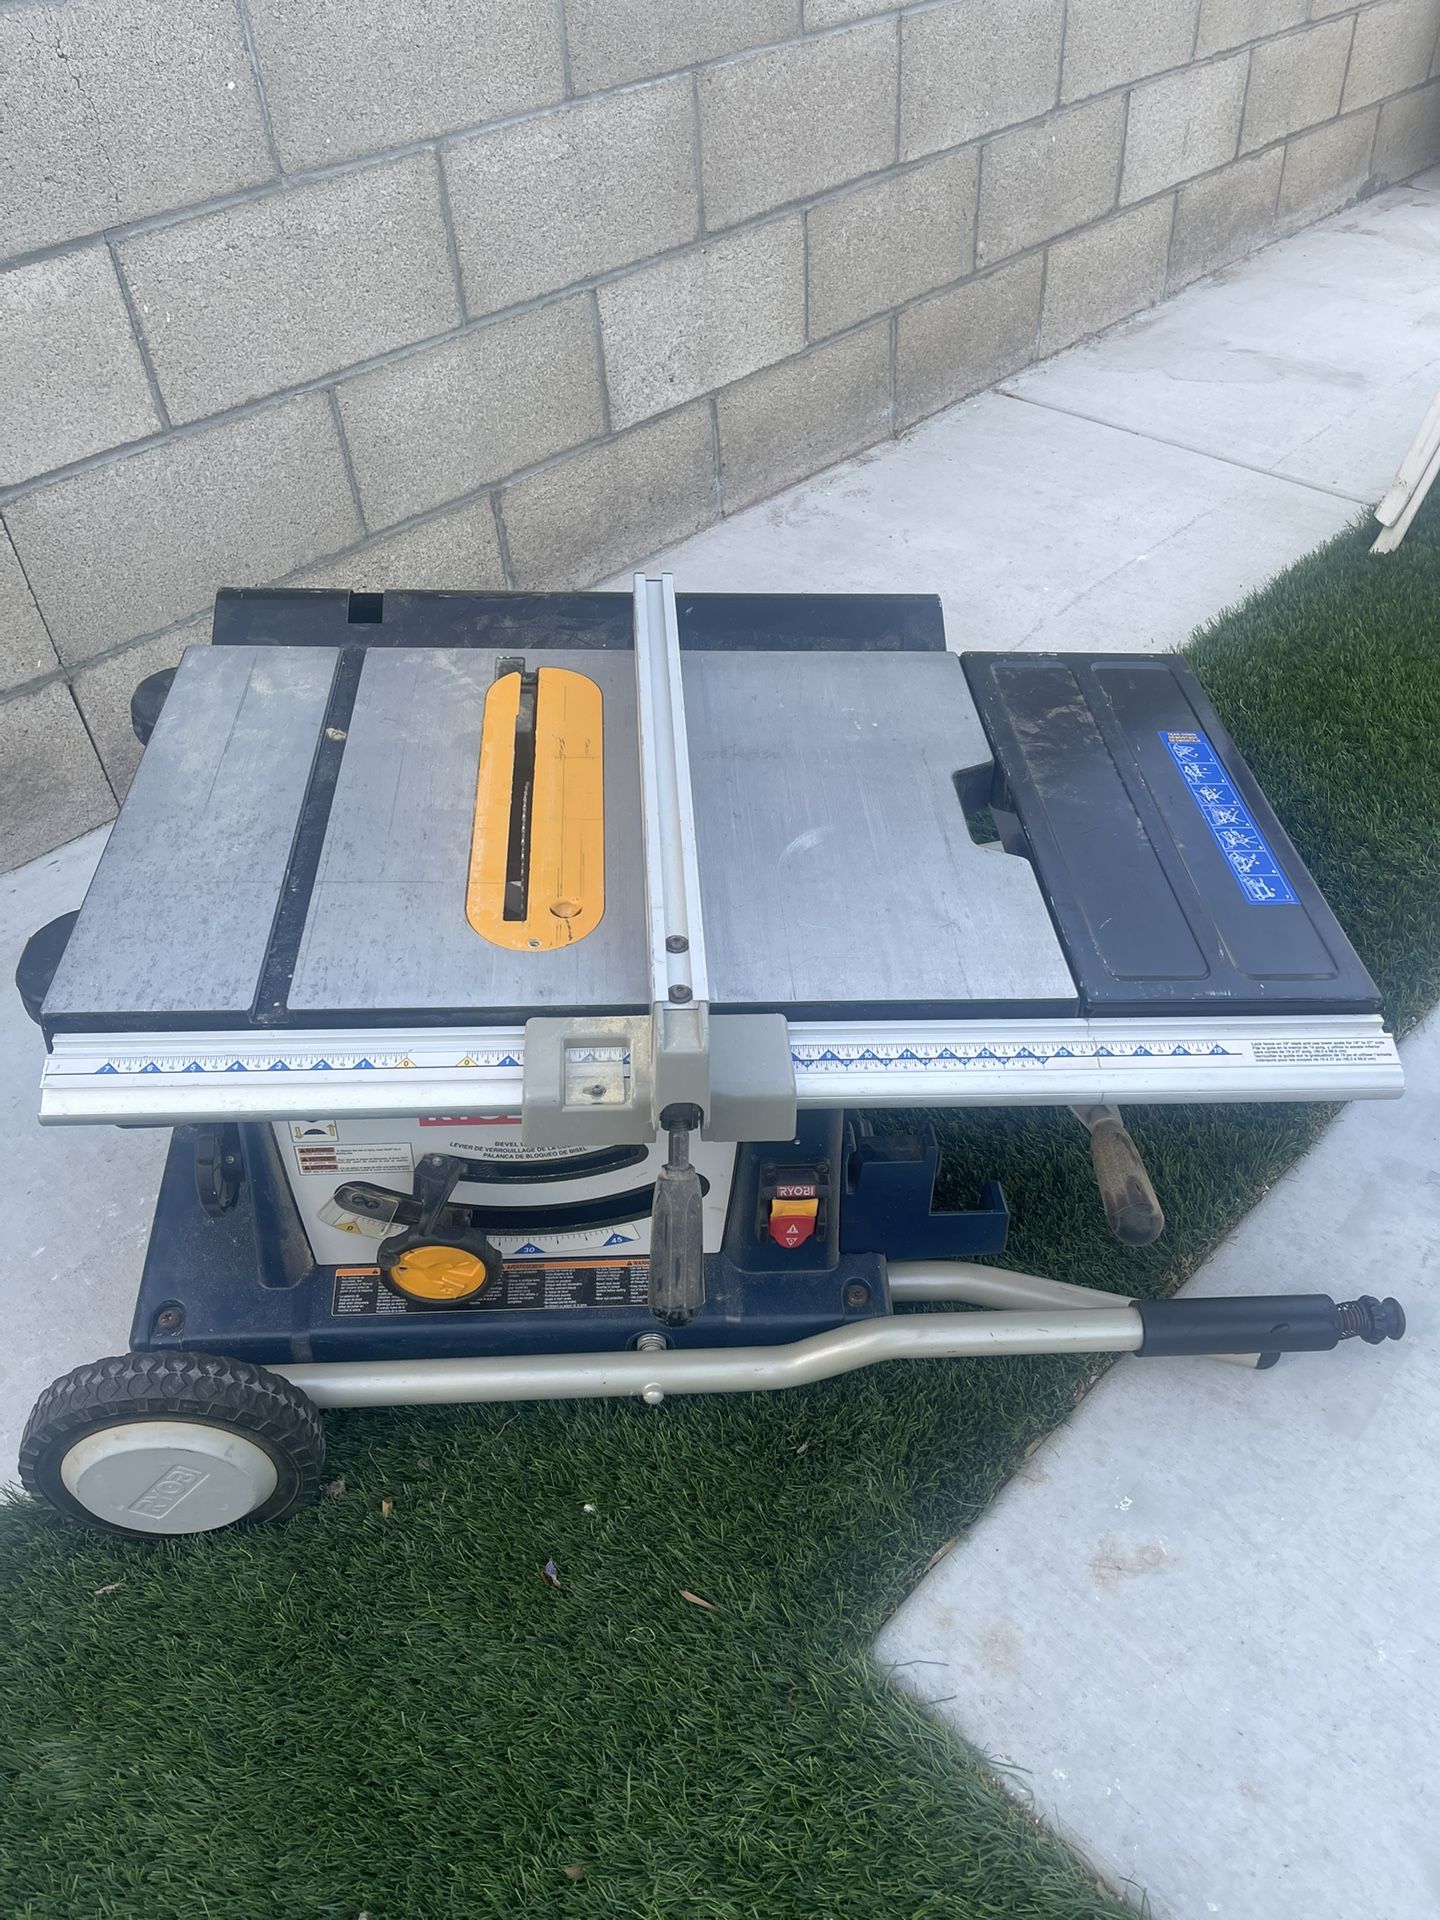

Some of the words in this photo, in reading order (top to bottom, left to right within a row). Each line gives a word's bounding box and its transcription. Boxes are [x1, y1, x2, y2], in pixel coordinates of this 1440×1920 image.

[450, 1142, 473, 1150] LEVIER
[780, 1186, 814, 1196] RYOBI
[132, 1467, 203, 1514] RYOBI
